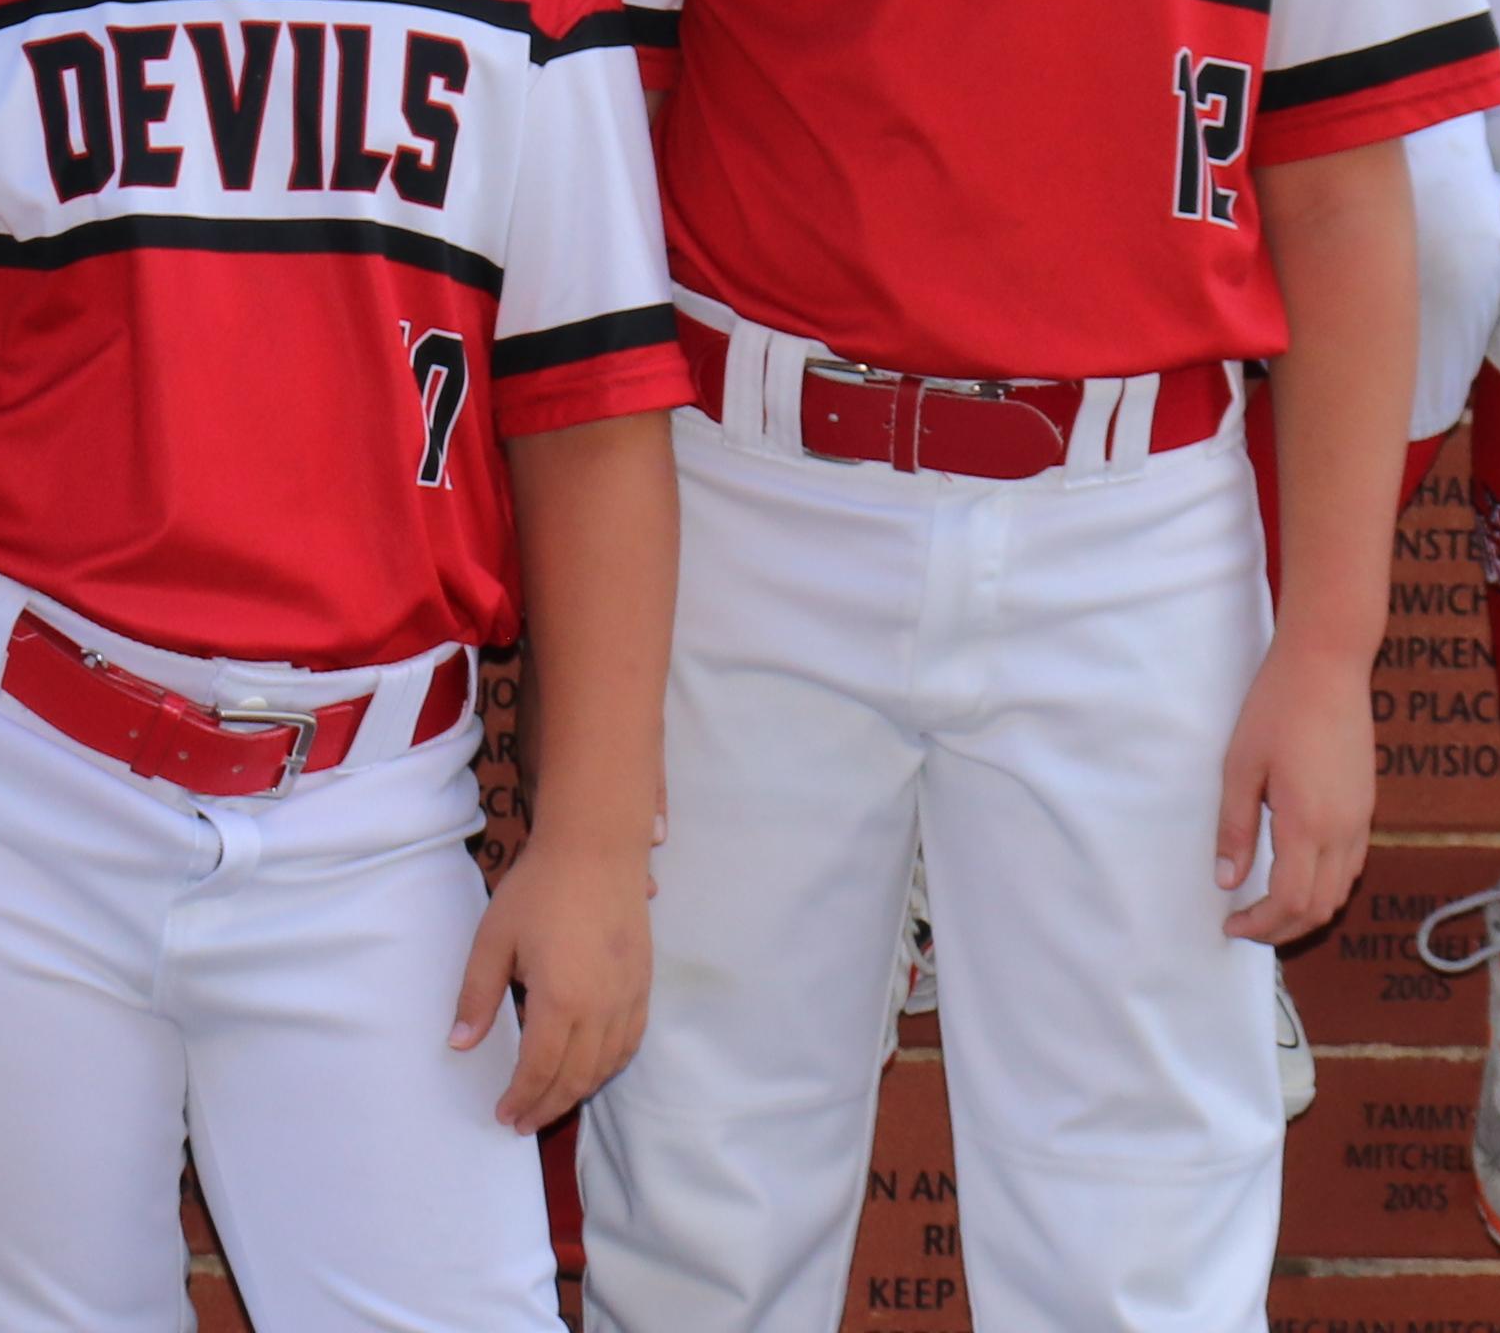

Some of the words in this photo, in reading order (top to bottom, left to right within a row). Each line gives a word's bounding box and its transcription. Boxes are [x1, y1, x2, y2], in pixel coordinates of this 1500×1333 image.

[23, 20, 470, 209] DEVILS
[1173, 47, 1251, 229] 12
[1408, 689, 1498, 725] PLAC
[1380, 973, 1454, 1001] 2005
[1383, 1183, 1449, 1212] 2005
